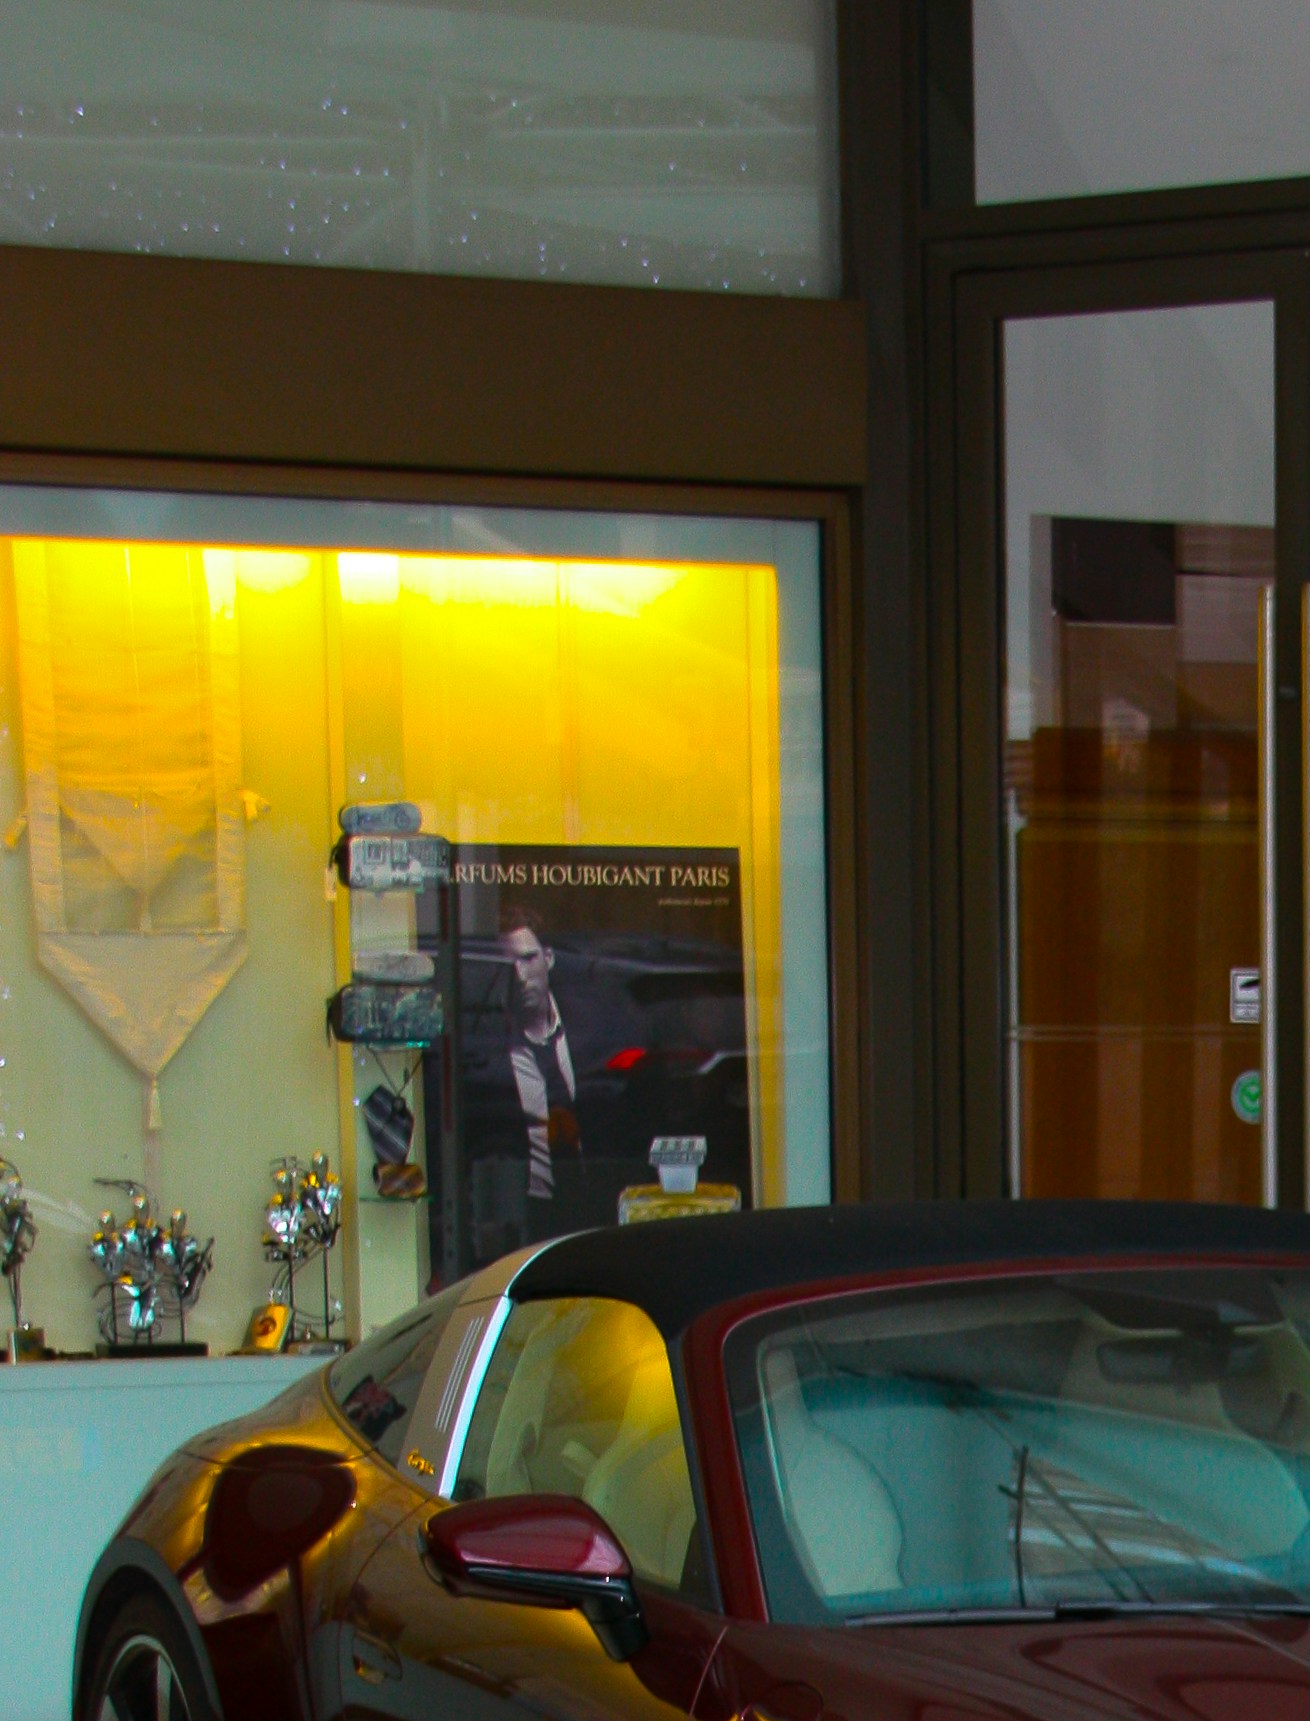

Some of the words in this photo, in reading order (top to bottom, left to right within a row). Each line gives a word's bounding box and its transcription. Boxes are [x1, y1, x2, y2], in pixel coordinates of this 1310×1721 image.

[450, 862, 527, 884] RFUMS
[532, 863, 665, 887] HOUBIGANT
[670, 865, 730, 888] PARIS
